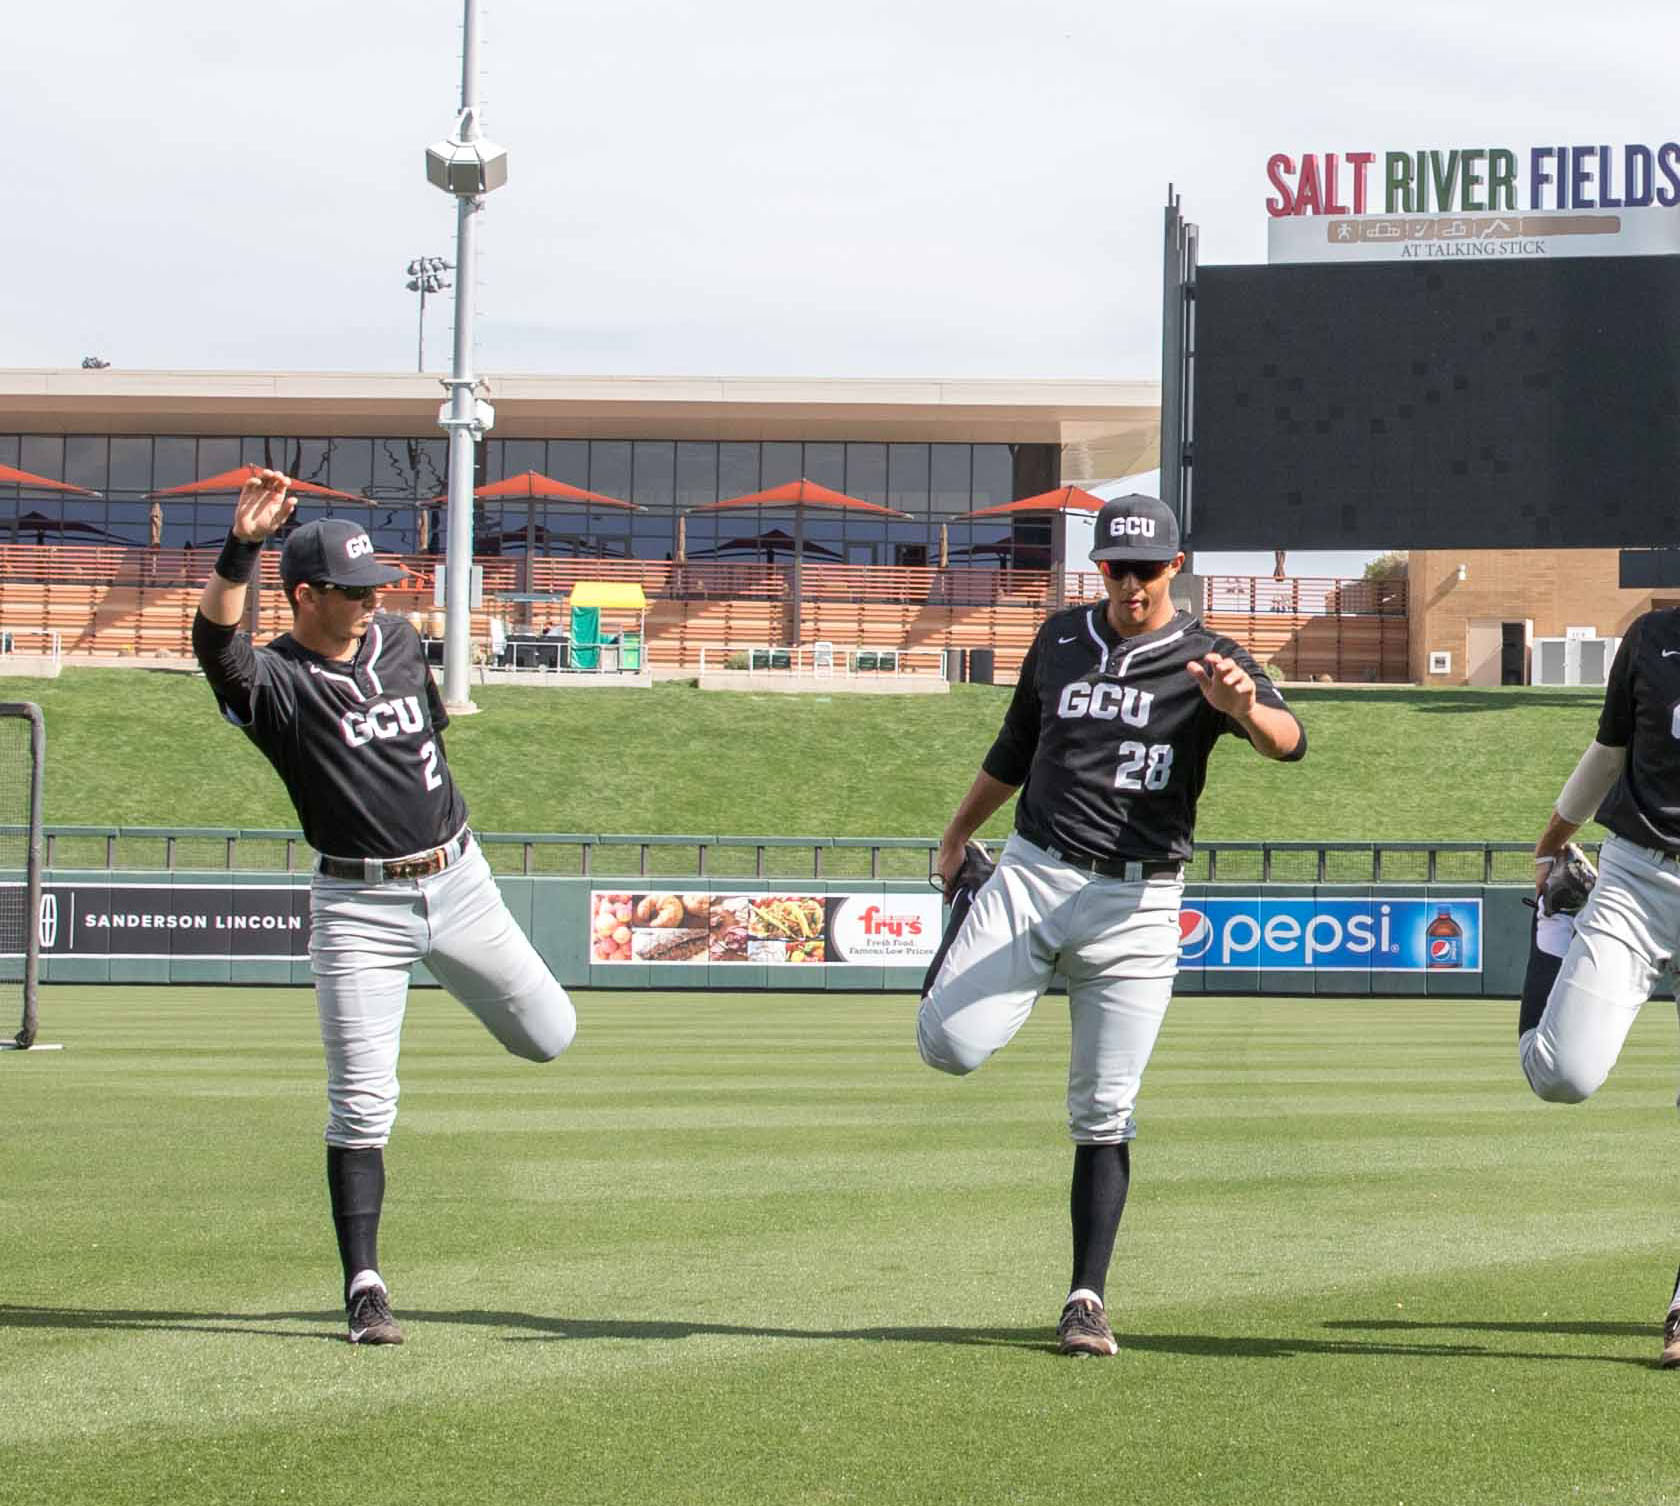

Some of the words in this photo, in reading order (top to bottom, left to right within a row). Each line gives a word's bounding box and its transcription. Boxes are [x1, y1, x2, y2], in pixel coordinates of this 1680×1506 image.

[1266, 152, 1376, 218] SALT
[1385, 148, 1518, 213] RIVER
[1401, 245, 1421, 258] AT
[1425, 242, 1495, 257] TALKING
[1498, 240, 1546, 255] STICK
[1110, 517, 1156, 537] GCU
[340, 696, 424, 748] GCU
[1057, 681, 1155, 728] GCU
[420, 741, 442, 791] 2
[1114, 740, 1174, 790] 28
[84, 914, 207, 928] SANDERSON
[216, 916, 302, 929] LINCOLN
[858, 905, 922, 937] fry's
[1223, 904, 1390, 964] pepsi
